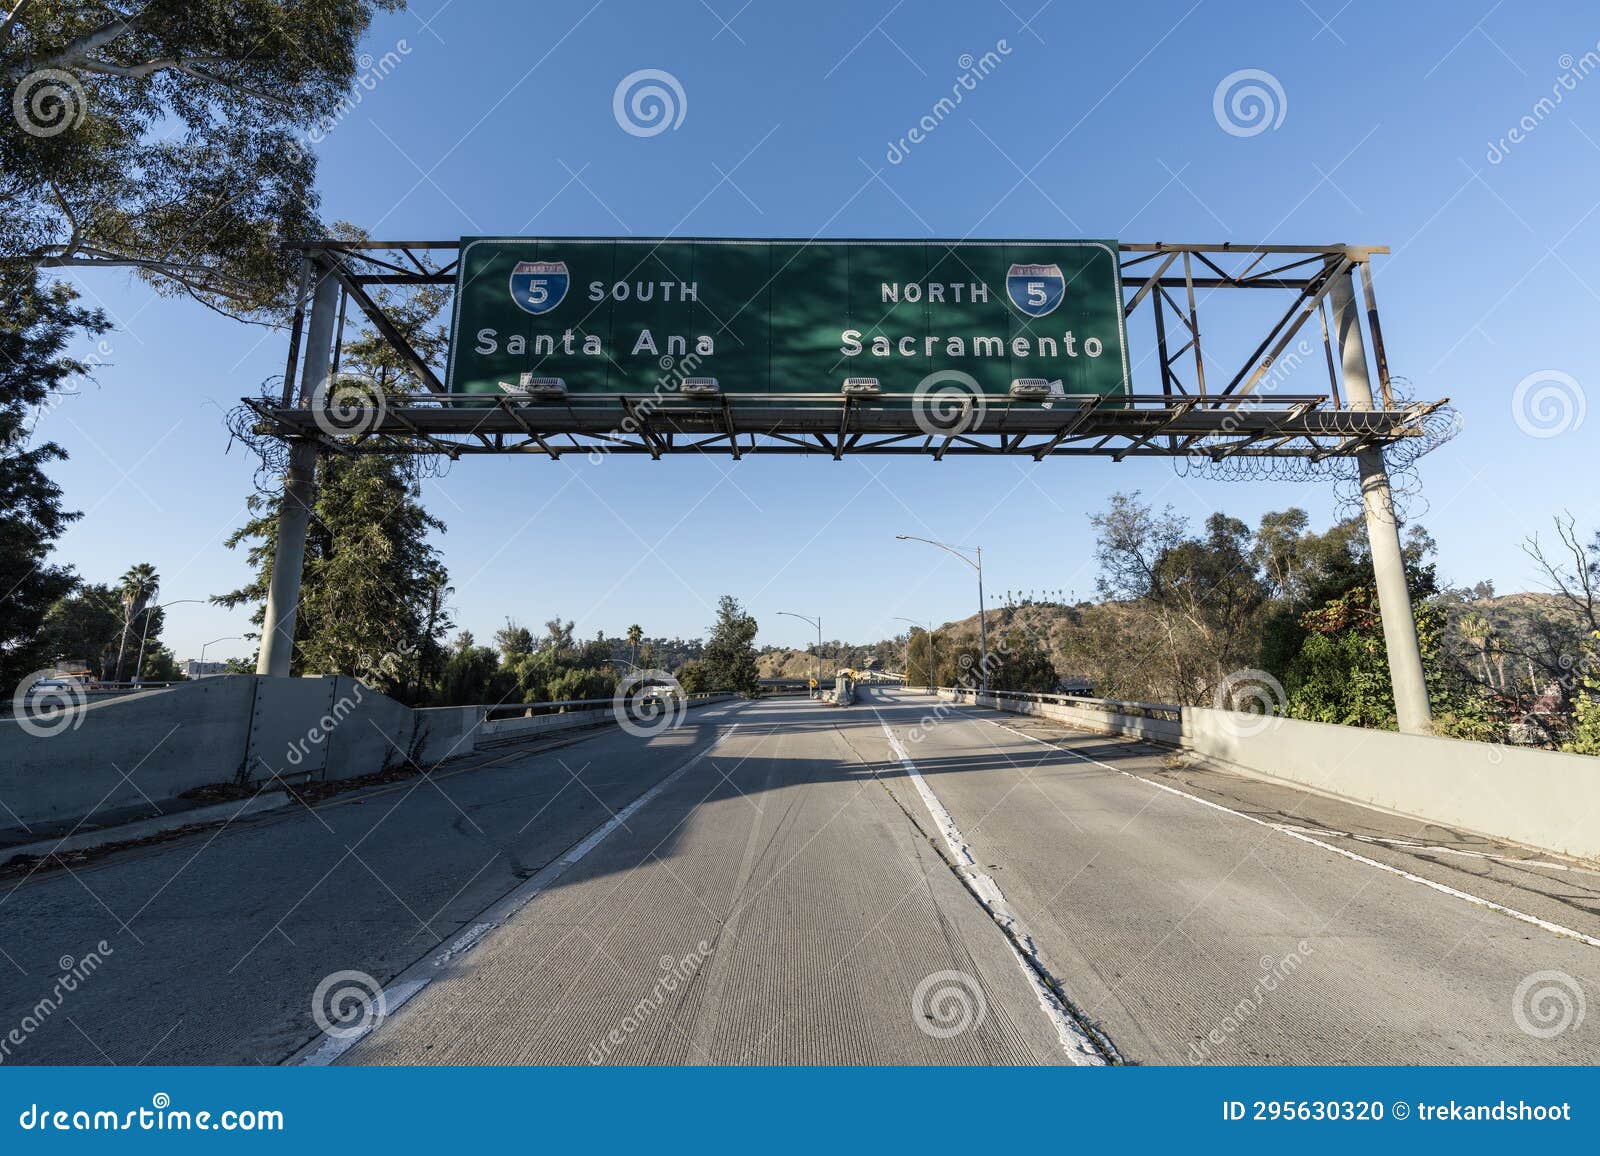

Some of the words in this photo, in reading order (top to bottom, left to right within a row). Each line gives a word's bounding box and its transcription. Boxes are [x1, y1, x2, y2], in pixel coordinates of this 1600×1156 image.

[528, 279, 549, 304] 5
[588, 281, 698, 302] SOUTH
[881, 282, 988, 303] NORTH
[1027, 281, 1048, 306] 5
[474, 328, 602, 355] Santa
[631, 329, 715, 356] Ana
[840, 329, 1103, 358] Sacramento
